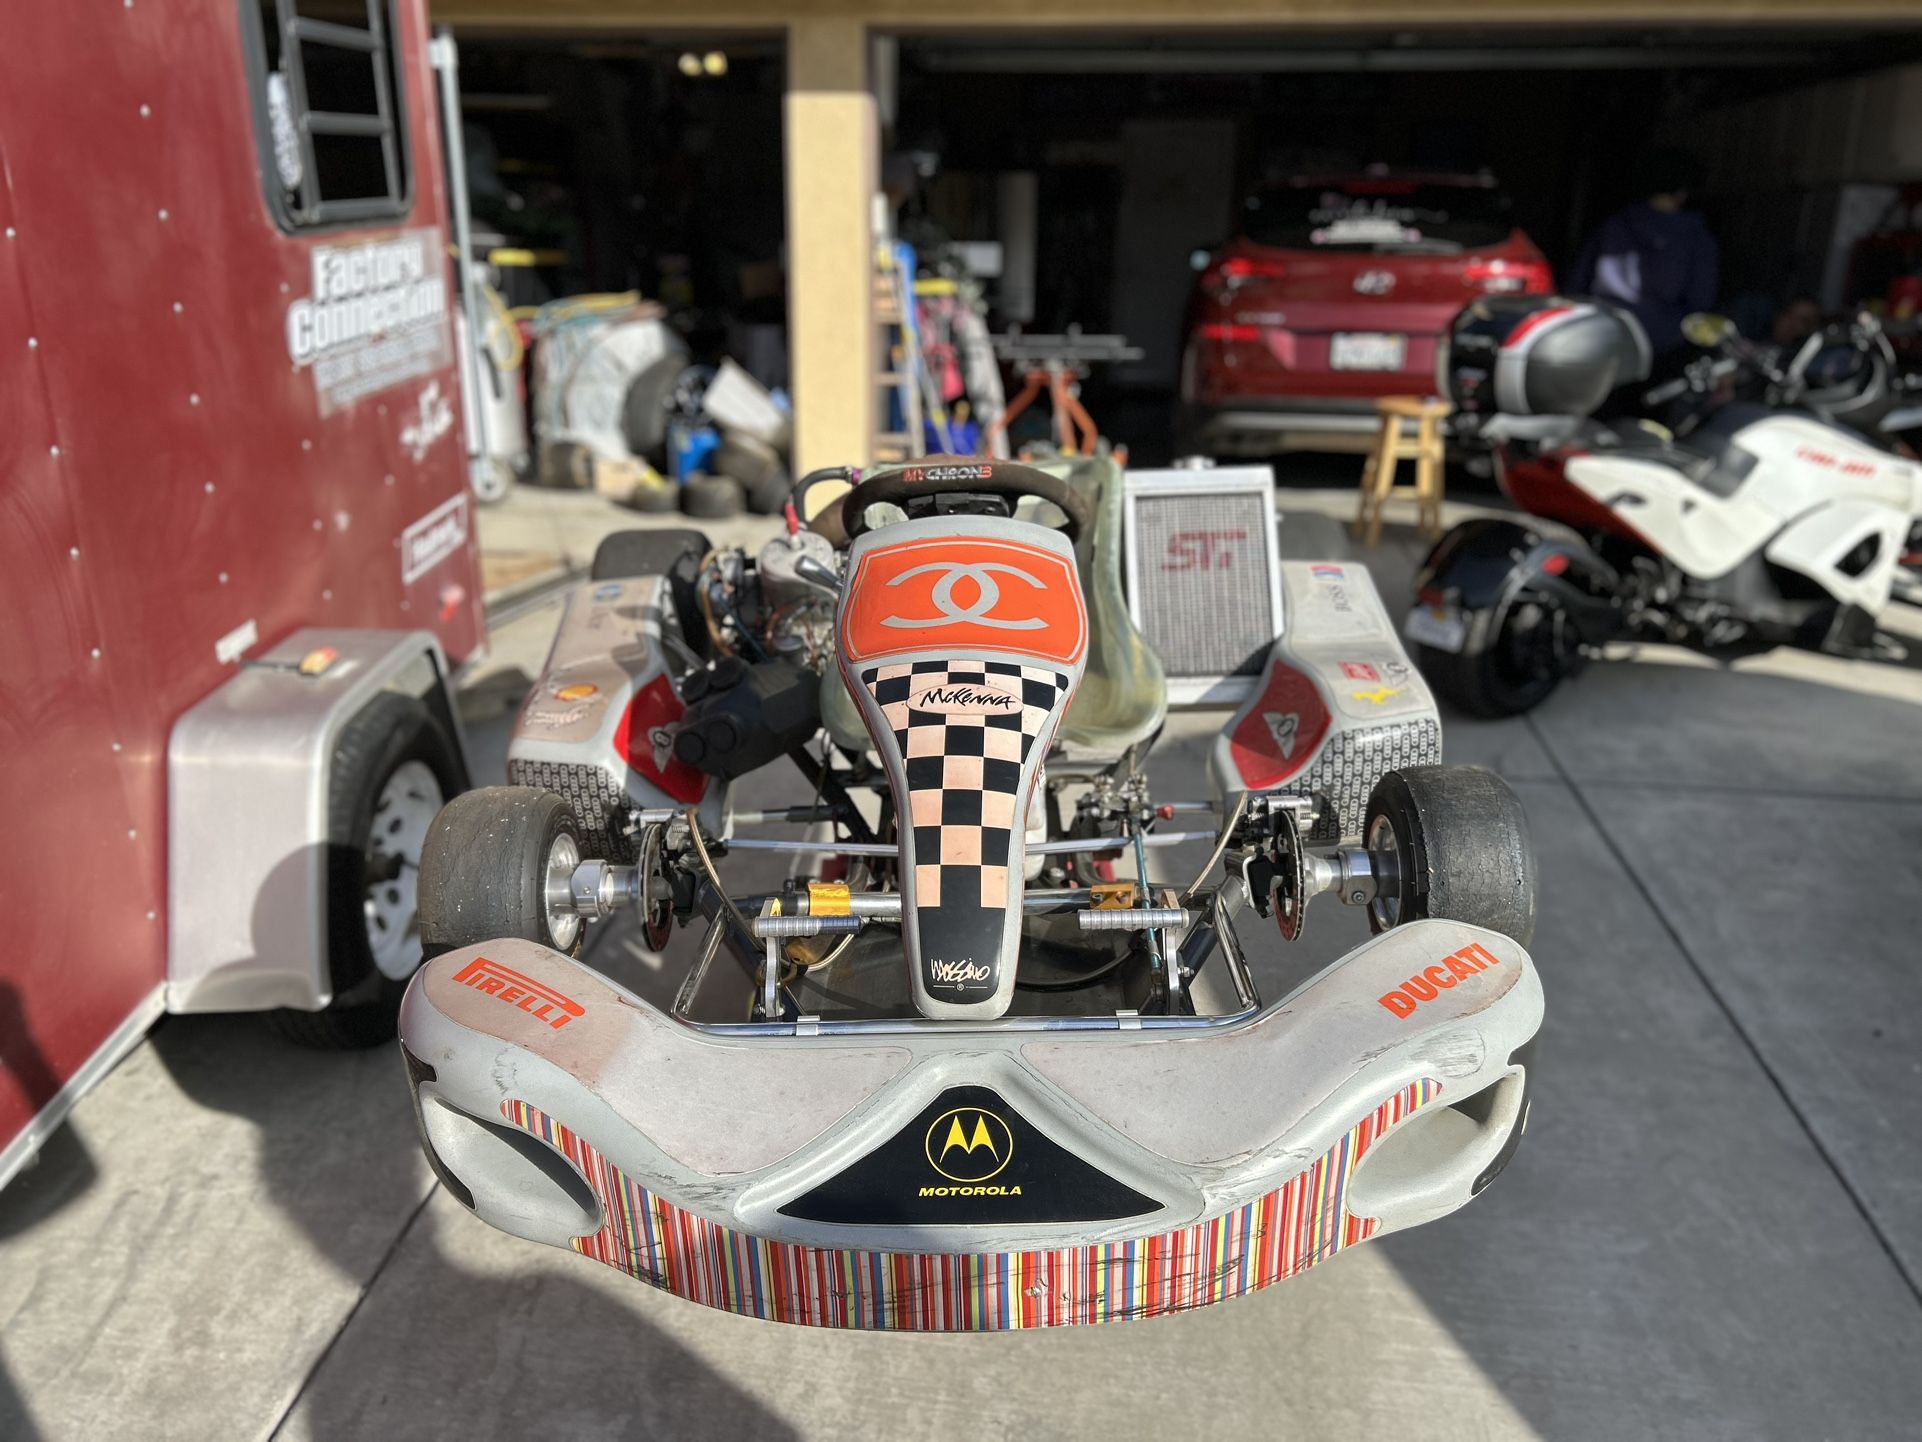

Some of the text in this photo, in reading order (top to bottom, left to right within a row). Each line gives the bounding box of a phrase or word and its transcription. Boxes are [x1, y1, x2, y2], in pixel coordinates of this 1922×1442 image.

[312, 241, 423, 301] Factory
[452, 956, 586, 1030] PIRELLI
[1376, 942, 1500, 1020] DUCATI
[918, 1185, 1022, 1197] MOTOROLA
